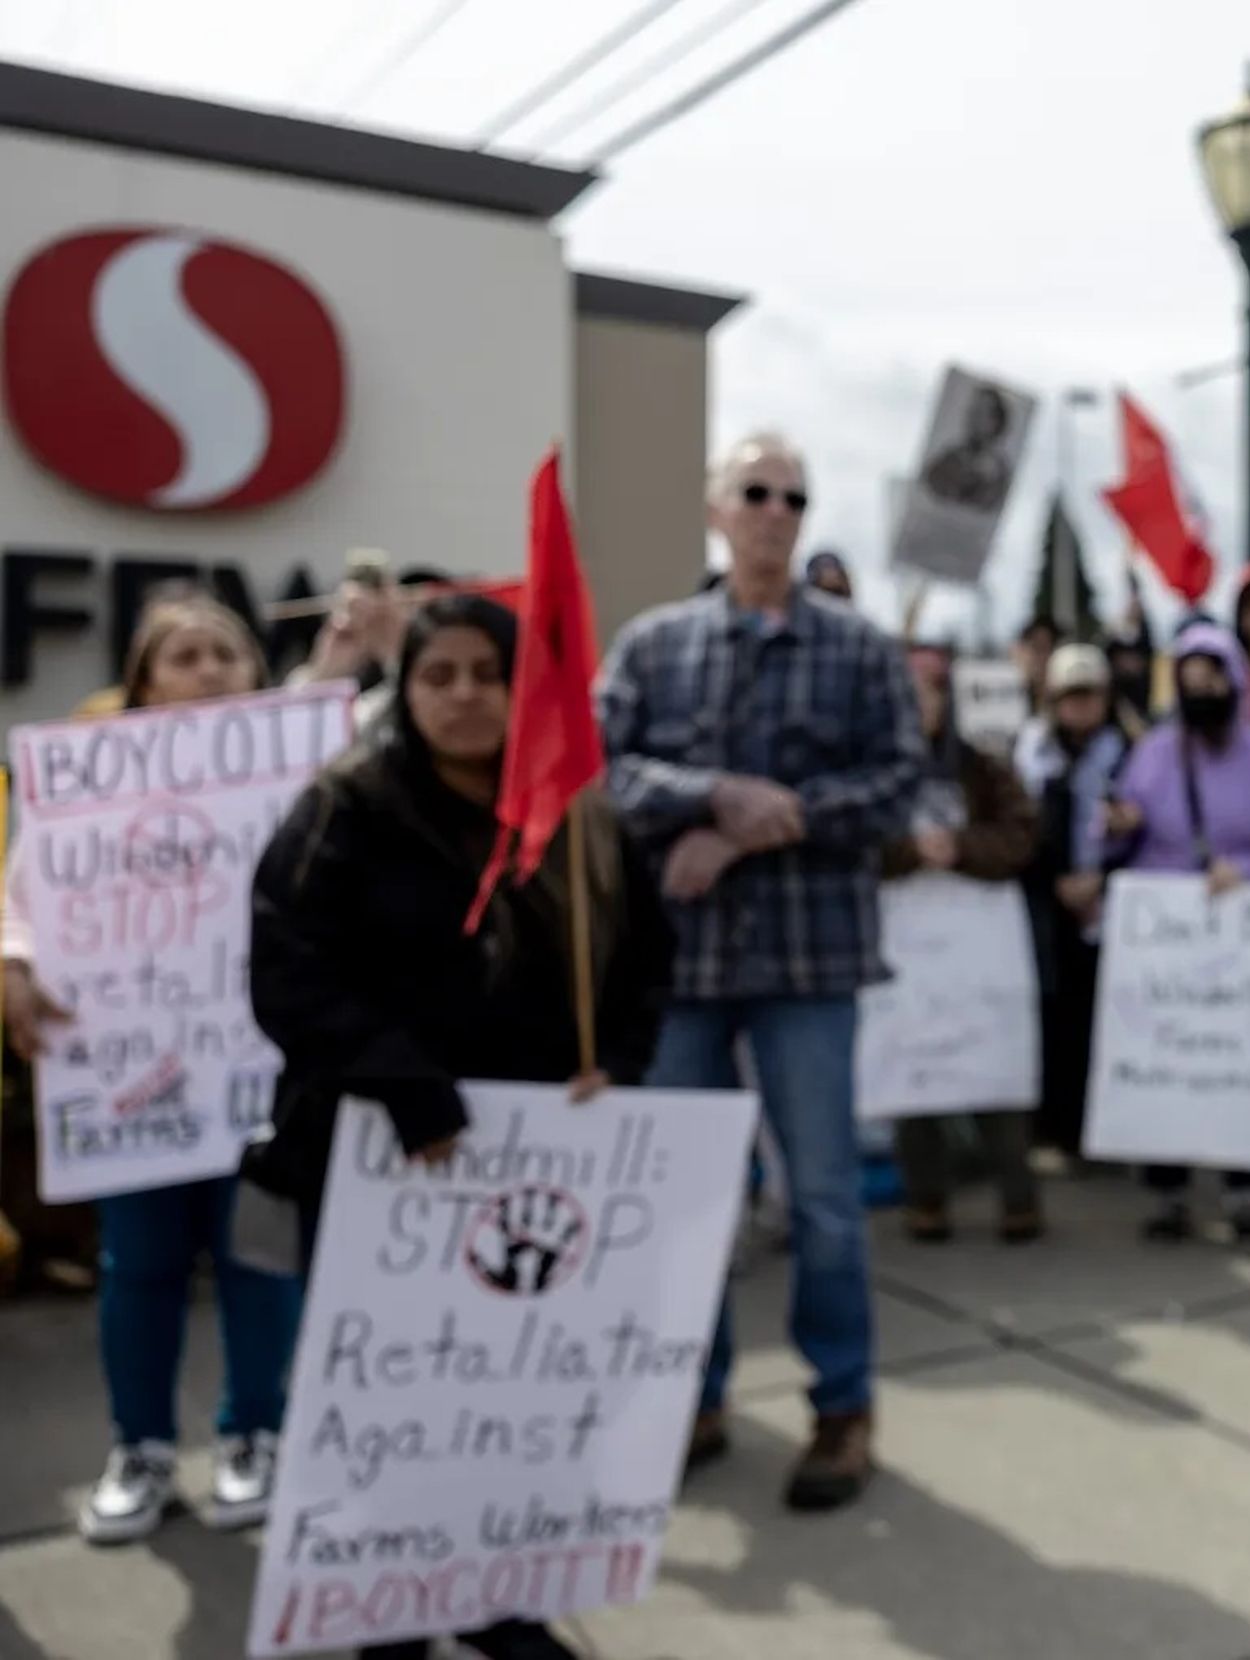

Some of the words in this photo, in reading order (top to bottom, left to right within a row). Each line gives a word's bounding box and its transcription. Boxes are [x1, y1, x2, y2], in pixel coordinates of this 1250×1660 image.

[57, 870, 231, 957] STOP
[58, 937, 250, 1010] retali
[322, 1308, 705, 1389] Retaliation
[309, 1391, 604, 1489] Against
[284, 1500, 455, 1567] Farms
